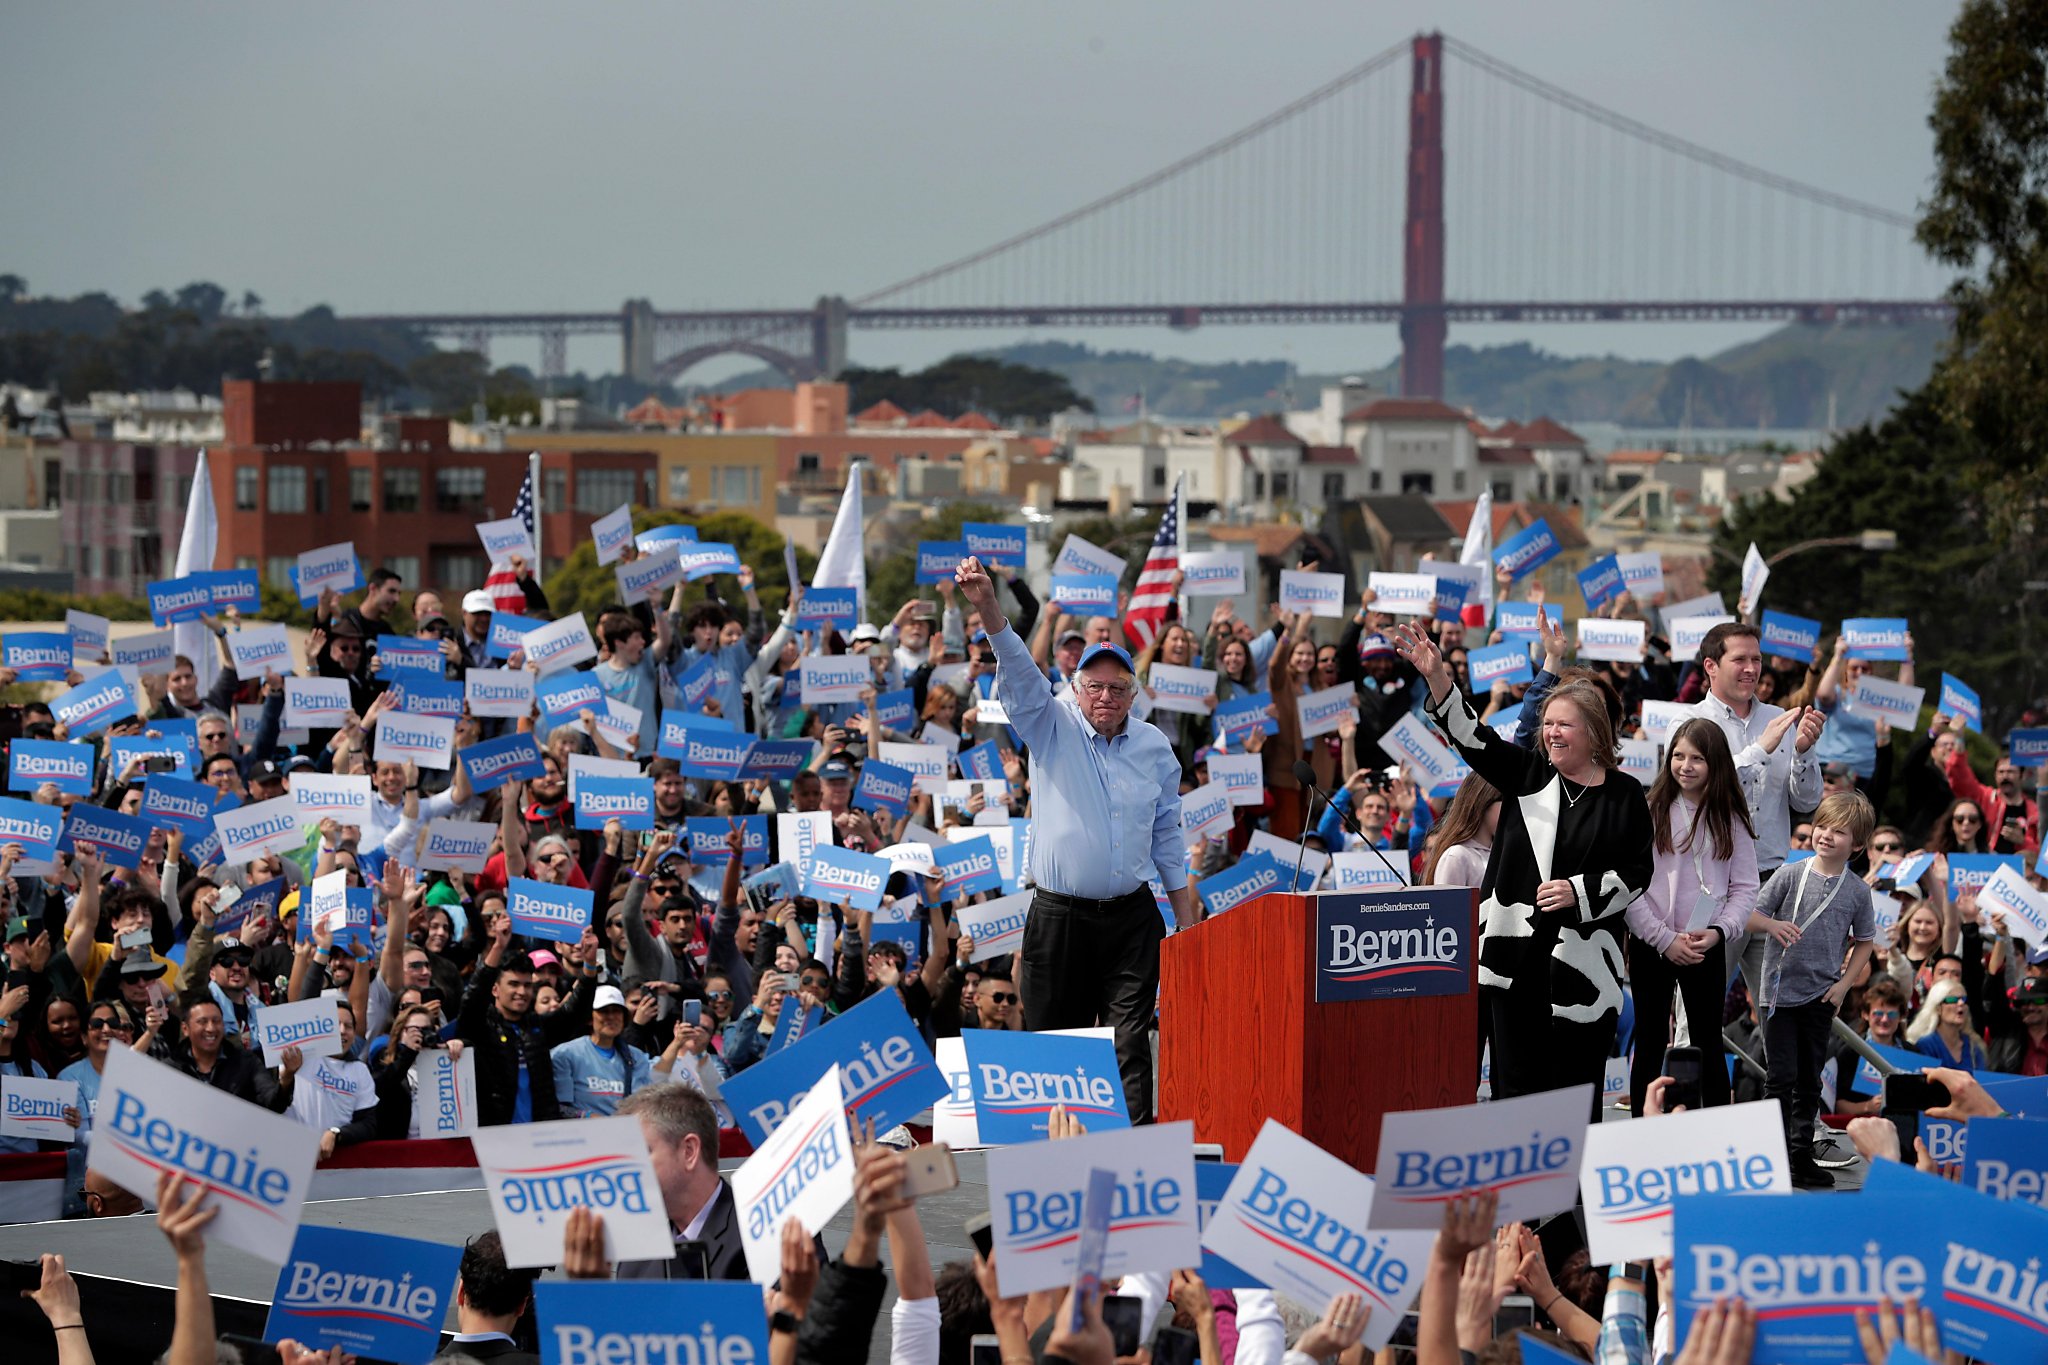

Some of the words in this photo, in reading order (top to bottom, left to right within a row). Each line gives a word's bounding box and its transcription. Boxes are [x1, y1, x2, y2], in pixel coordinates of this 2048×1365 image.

[485, 532, 525, 549] Bernie
[967, 535, 1023, 553] Bernie
[1501, 532, 1552, 571] Bernie
[302, 558, 349, 582] Bernie
[680, 551, 735, 568] Bernie
[922, 553, 966, 570] Berni
[1184, 562, 1239, 579] Bernie
[624, 560, 678, 590] Bernie
[1583, 566, 1621, 593] Bernie
[154, 587, 208, 611] Bernie
[1056, 586, 1113, 600] Bernie
[1285, 582, 1338, 599] Bernie
[1375, 585, 1430, 599] Bernie
[800, 599, 852, 615] Bernie
[493, 624, 523, 644] Ber
[530, 628, 585, 659] Bernie
[1584, 629, 1640, 646] Bernie
[1765, 624, 1814, 647] Bernie
[1847, 630, 1902, 645] Bernie
[8, 646, 71, 665] Bernie
[115, 643, 171, 664] Bernie
[236, 639, 287, 662] Bernie
[381, 651, 440, 672] Bernie
[1472, 652, 1526, 675] Bernie
[807, 669, 865, 685] Bernie
[1154, 677, 1209, 696] Bernie
[292, 692, 348, 709] Bernie
[471, 683, 529, 699] Bernie
[544, 682, 600, 712] Bernie
[1859, 687, 1915, 714] Bernie
[59, 685, 124, 722] Bernie
[408, 694, 461, 713] Bernie
[382, 726, 446, 750] Bernie
[2015, 740, 2048, 750] Ber
[468, 747, 535, 774] Bernie
[749, 751, 802, 769] Bernie
[1395, 725, 1443, 779] Bernie
[15, 753, 87, 776] Bernie
[297, 788, 365, 807] Bernie
[580, 791, 649, 811] Bernie
[862, 776, 908, 803] Bernie
[146, 788, 208, 818] Bernie
[1184, 797, 1227, 828] Bernie
[68, 817, 141, 851] Bernie
[225, 813, 294, 845] Bernie
[429, 835, 487, 855] Bernie
[811, 861, 881, 890] Bernie
[1953, 867, 1991, 885] Ber
[1212, 867, 1278, 911] Bernie
[314, 888, 344, 915] Bernie
[512, 893, 586, 924] Bernie
[1360, 902, 1430, 914] BernieSanders.com
[1991, 879, 2047, 932] Bernie
[967, 908, 1027, 940] Berni
[1330, 914, 1459, 967] Bernie
[265, 1015, 334, 1045] Bernie
[437, 1054, 456, 1132] Bernie
[587, 1075, 625, 1094] Bern
[978, 1063, 1115, 1107] Bernie
[109, 1088, 290, 1206] Bernie
[1391, 1130, 1571, 1190] Bernie
[747, 1122, 842, 1242] Bernie
[1595, 1145, 1774, 1204] Bernie
[501, 1170, 652, 1223] Bernie
[1241, 1166, 1410, 1296] Bernie
[1691, 1240, 1926, 1300] Bernie
[285, 1260, 437, 1321] Bernie
[552, 1322, 756, 1365] Bernie
